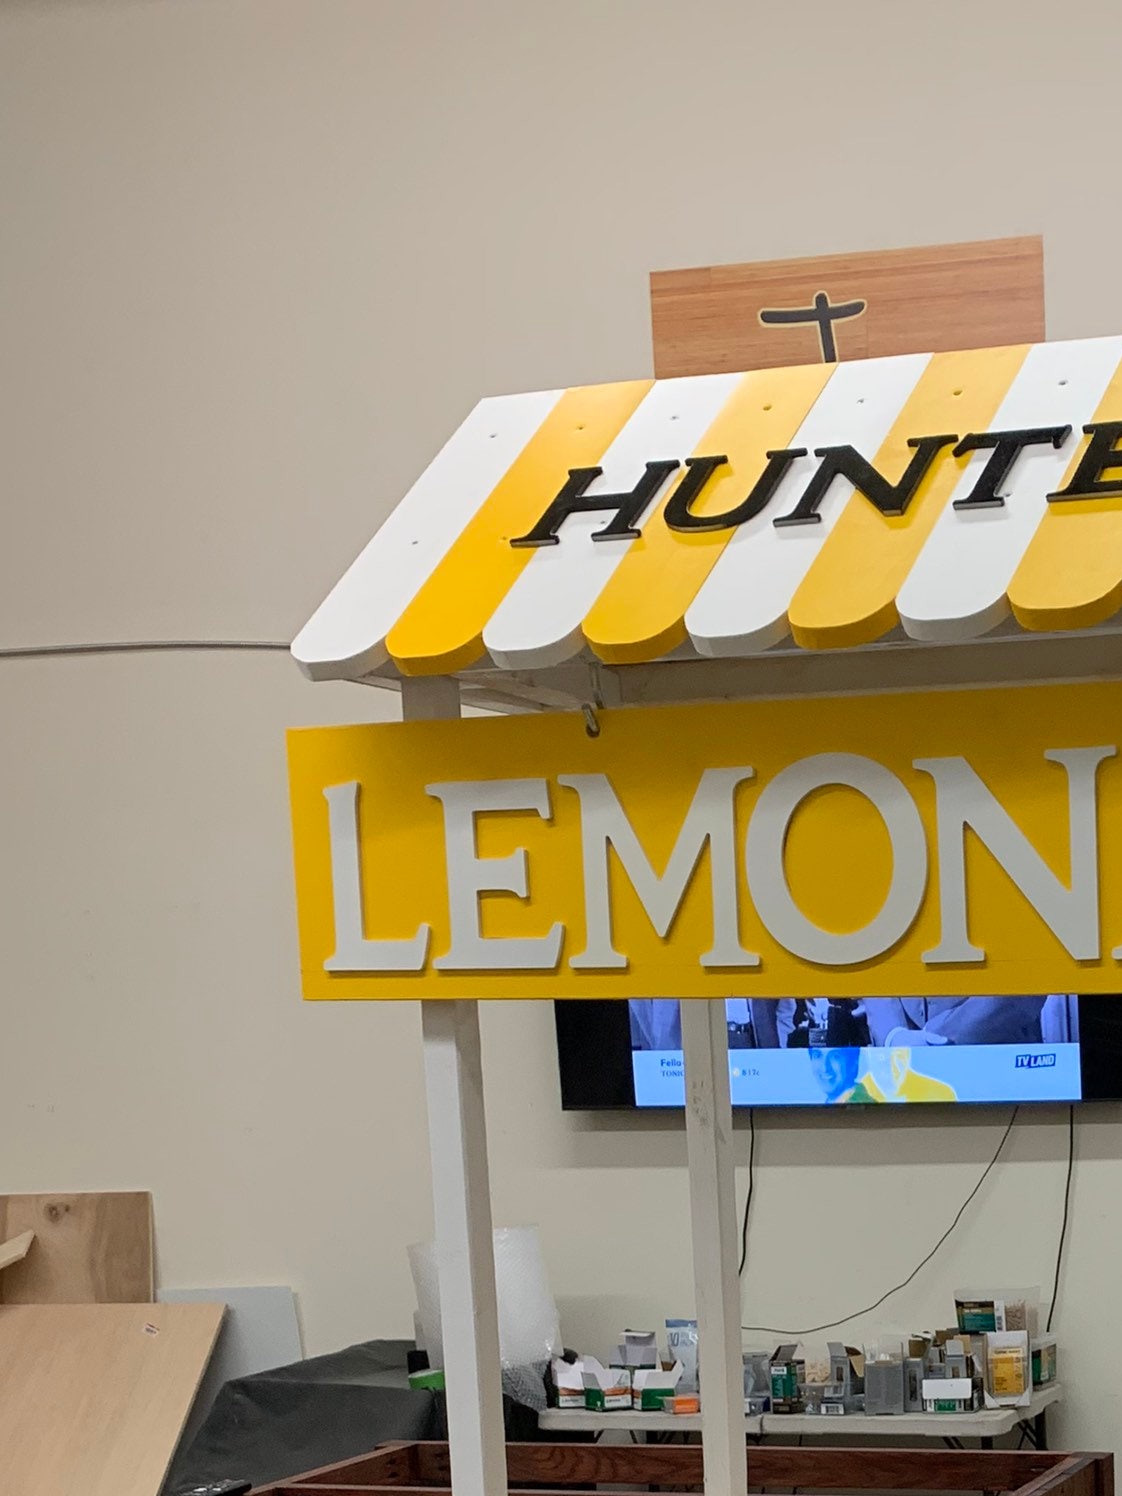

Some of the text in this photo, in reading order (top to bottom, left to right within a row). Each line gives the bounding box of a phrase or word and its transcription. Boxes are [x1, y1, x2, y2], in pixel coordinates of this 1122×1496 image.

[660, 1058, 684, 1068] Fello
[1017, 1055, 1054, 1067] TV LAND
